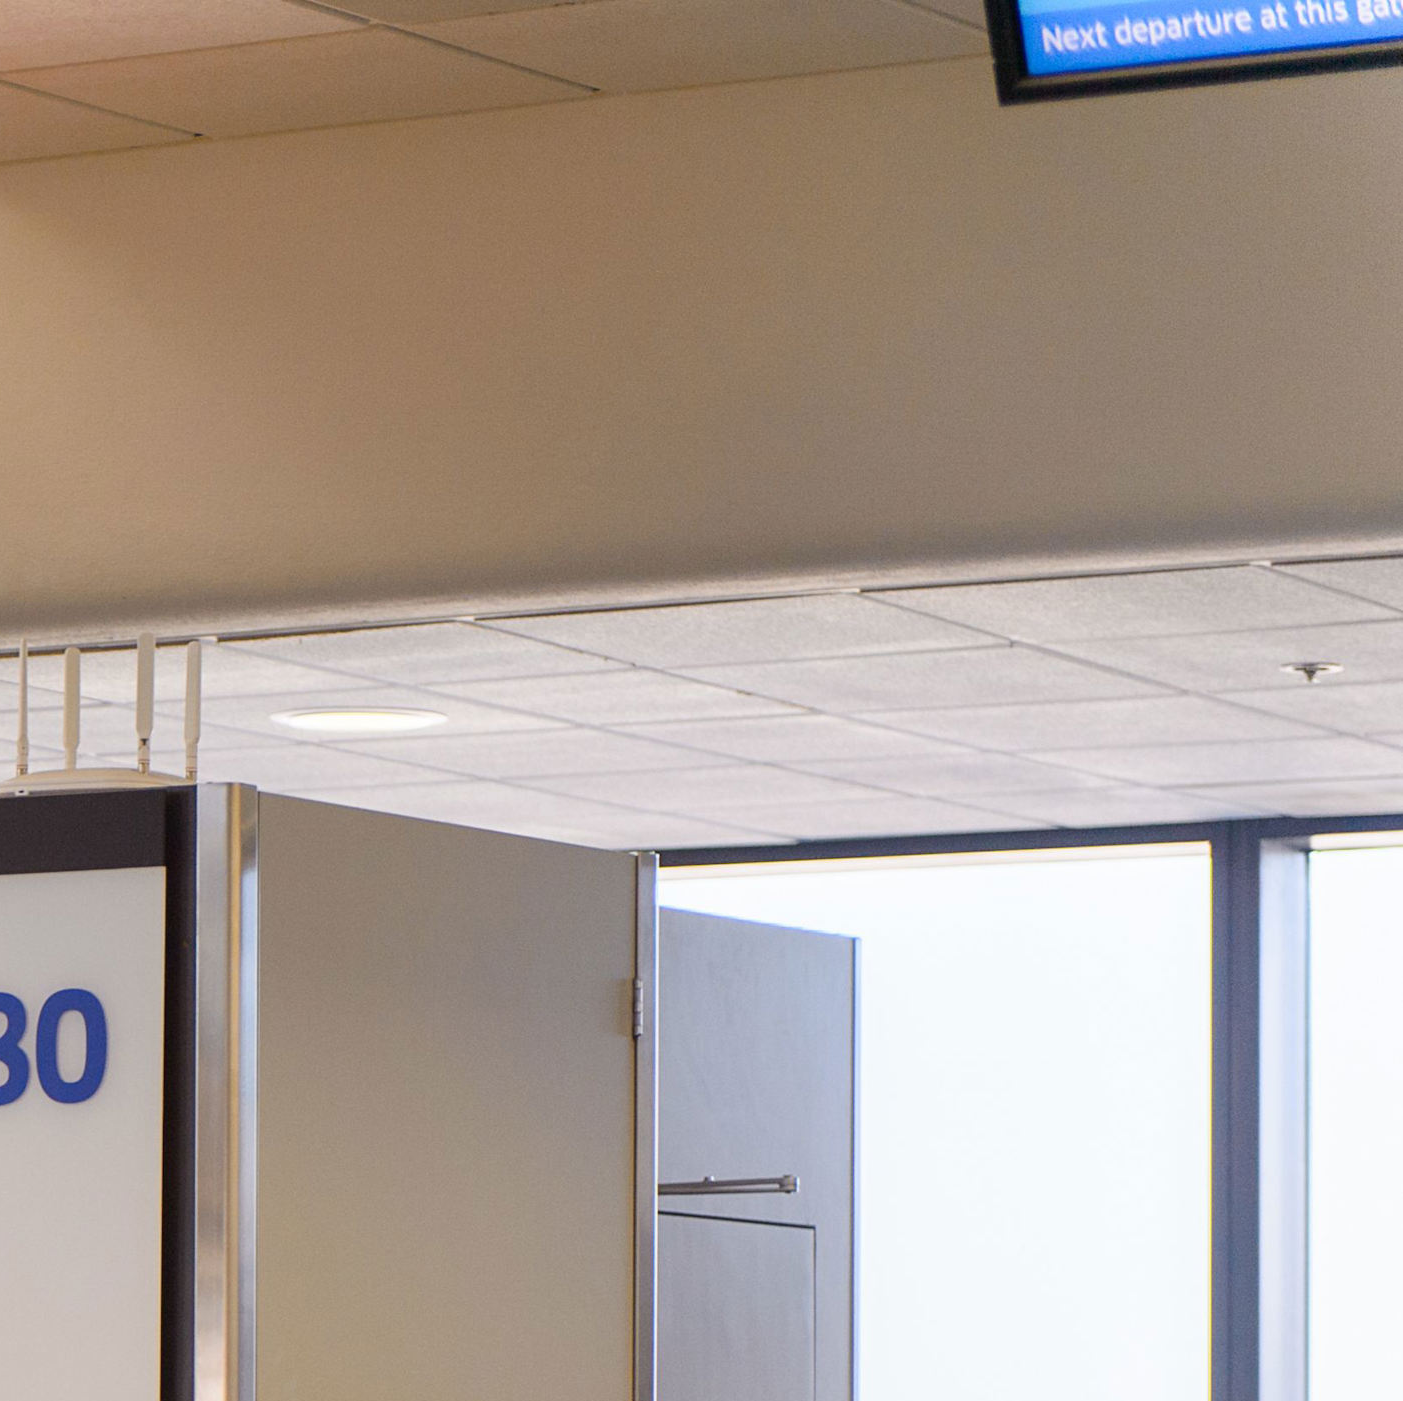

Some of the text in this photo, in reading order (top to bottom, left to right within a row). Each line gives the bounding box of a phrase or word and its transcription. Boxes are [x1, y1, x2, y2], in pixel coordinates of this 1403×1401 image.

[1041, 0, 1403, 54] Next departure at this gat
